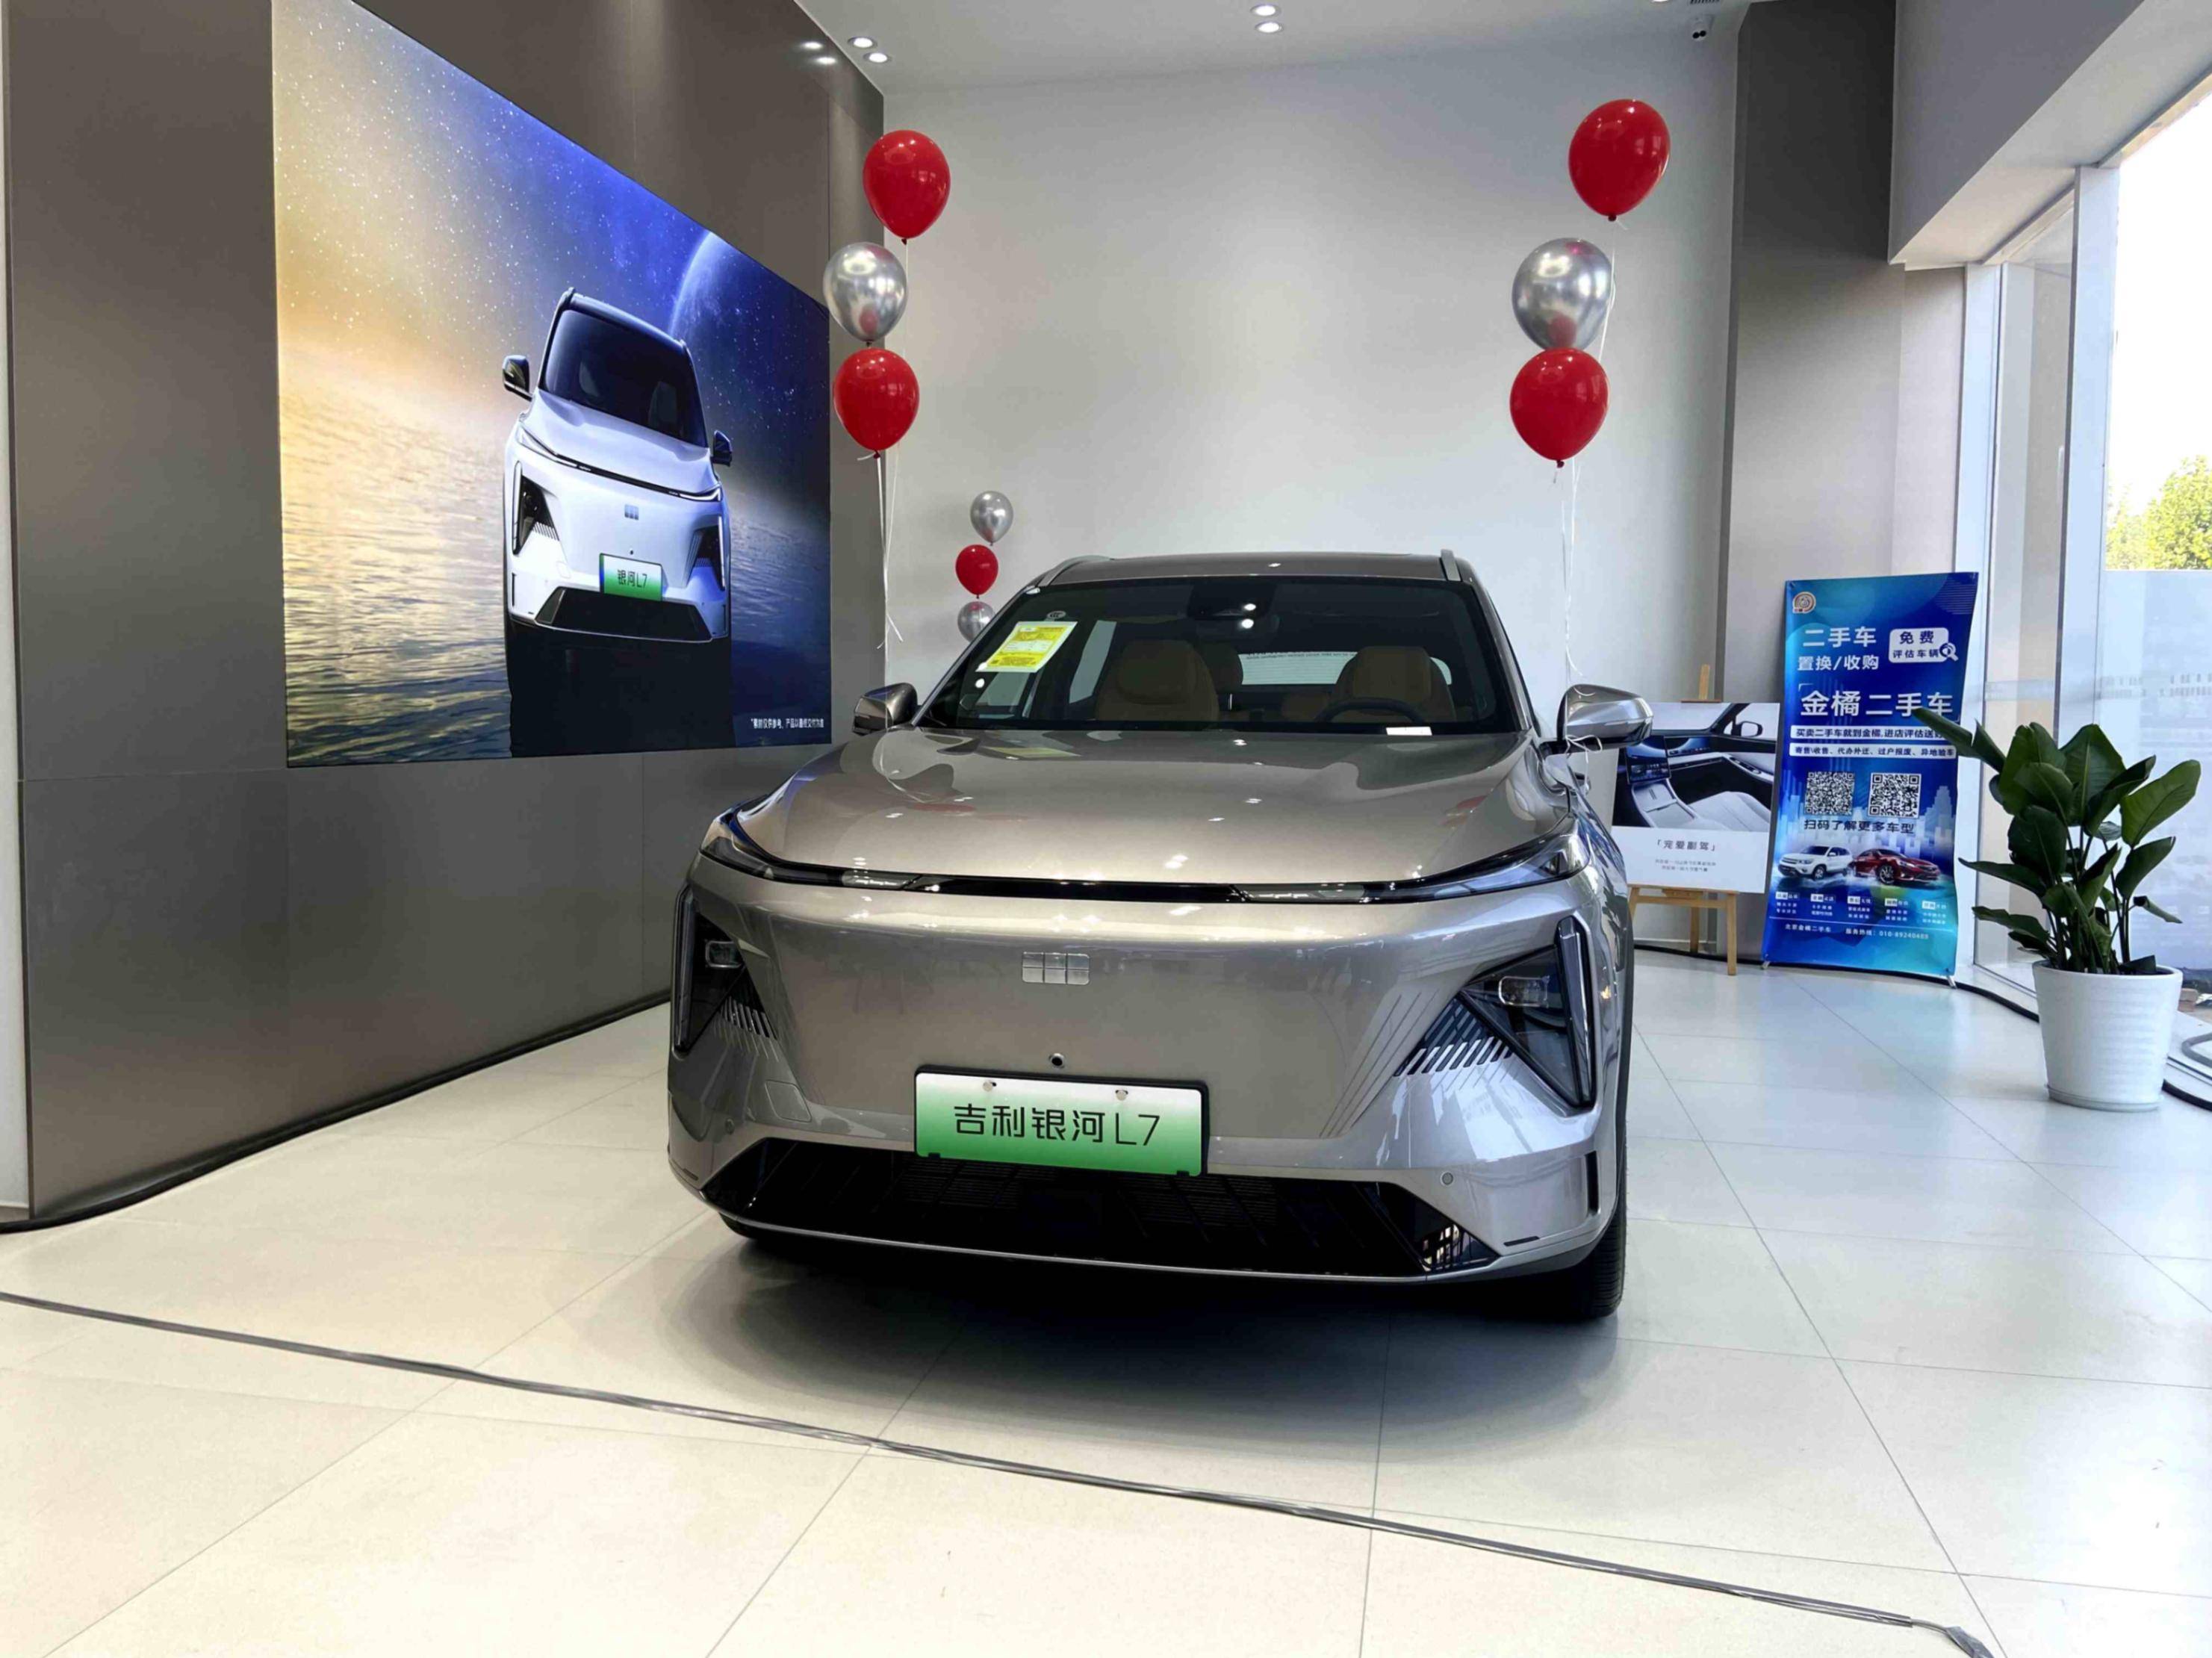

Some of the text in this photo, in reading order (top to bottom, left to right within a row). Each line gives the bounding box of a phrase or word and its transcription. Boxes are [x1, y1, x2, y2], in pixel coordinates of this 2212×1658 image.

[1803, 626, 1877, 648] 二手车
[1899, 630, 1934, 645] 免费
[1892, 648, 1940, 659] 评估车辆
[1797, 655, 1880, 671] 置换/收购
[1801, 690, 1954, 717] 金橘二手车
[1804, 820, 1915, 835] 扫码了解更多车型
[954, 1103, 1161, 1146] 吉利银河L7
